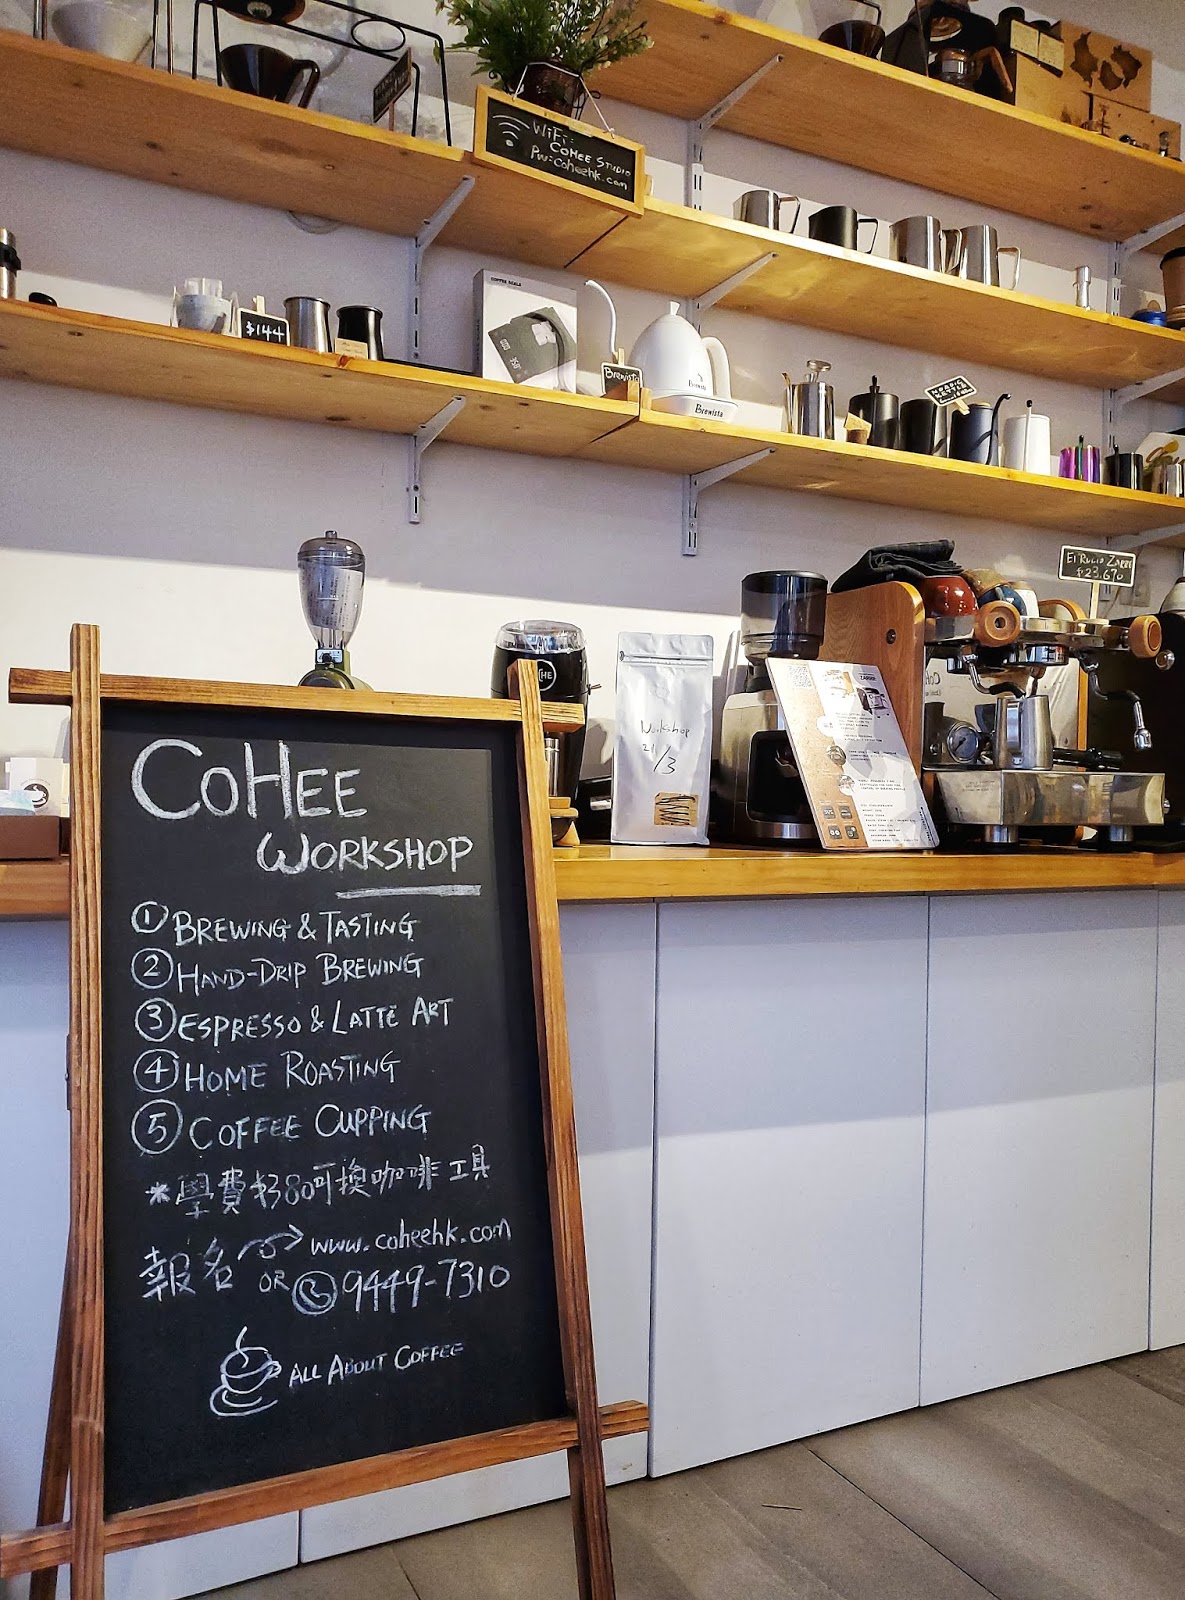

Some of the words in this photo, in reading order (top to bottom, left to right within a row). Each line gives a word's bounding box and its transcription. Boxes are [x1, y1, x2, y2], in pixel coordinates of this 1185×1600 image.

[596, 156, 632, 177] STUDIO
[245, 320, 286, 342] $144
[603, 366, 640, 382] Brewista
[695, 403, 724, 418] Brewista
[131, 738, 367, 819] COHEE
[256, 832, 473, 874] WORKSHOP
[172, 910, 291, 946] BREWING
[297, 912, 316, 941] &
[319, 910, 418, 945] TASTING
[176, 957, 307, 997] HAND-DRIP
[316, 952, 425, 986] BREWING
[178, 1011, 302, 1047] ESPRESSO
[310, 1004, 325, 1033] &
[332, 999, 399, 1035] LATTE
[411, 996, 454, 1026] ART
[184, 1062, 268, 1093] HOME
[280, 1050, 401, 1088] ROASTING
[189, 1114, 302, 1150] COFFEE
[314, 1103, 432, 1138] CUPPING
[310, 1218, 512, 1256] www.coheehk.com
[259, 1269, 291, 1293] OR
[342, 1258, 511, 1313] 9449-7310
[289, 1362, 322, 1388] ALL
[327, 1353, 388, 1386] ABOUT
[394, 1342, 464, 1370] COFFEE
